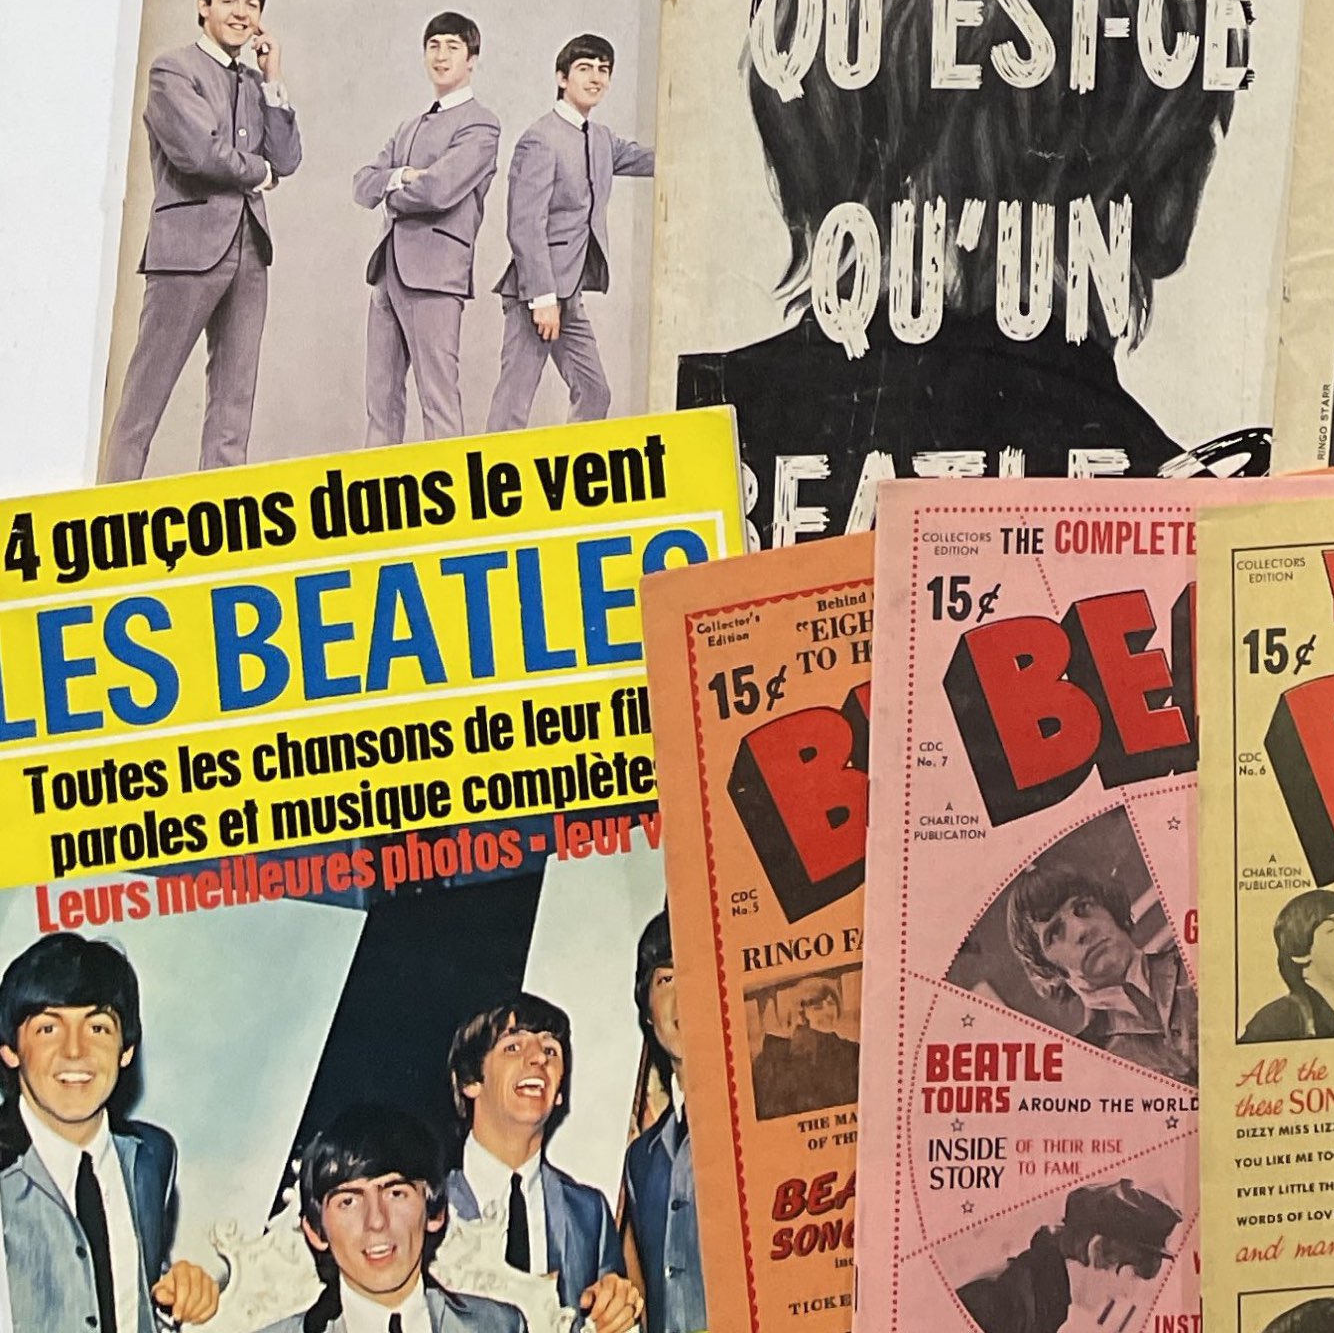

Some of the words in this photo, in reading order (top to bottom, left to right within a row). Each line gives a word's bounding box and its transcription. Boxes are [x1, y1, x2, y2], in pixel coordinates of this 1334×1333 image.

[810, 193, 1135, 360] QU'UN
[4, 512, 42, 584] 4
[52, 489, 297, 583] garçons
[309, 468, 456, 541] dans
[467, 450, 523, 519] le
[534, 435, 669, 512] vent
[696, 612, 761, 634] Collector's
[707, 631, 750, 648] Edition
[708, 664, 788, 721] 15¢
[919, 815, 979, 826] CHARLTON
[914, 829, 987, 842] PUBLICATION
[741, 935, 836, 973] RINGO
[925, 1043, 1064, 1083] BEATLE
[921, 1086, 1011, 1114] TOURS
[1018, 1098, 1091, 1112] AROUND
[1100, 1098, 1134, 1112] THE
[928, 1137, 1008, 1163] INSIDE
[929, 1165, 1006, 1190] STORY
